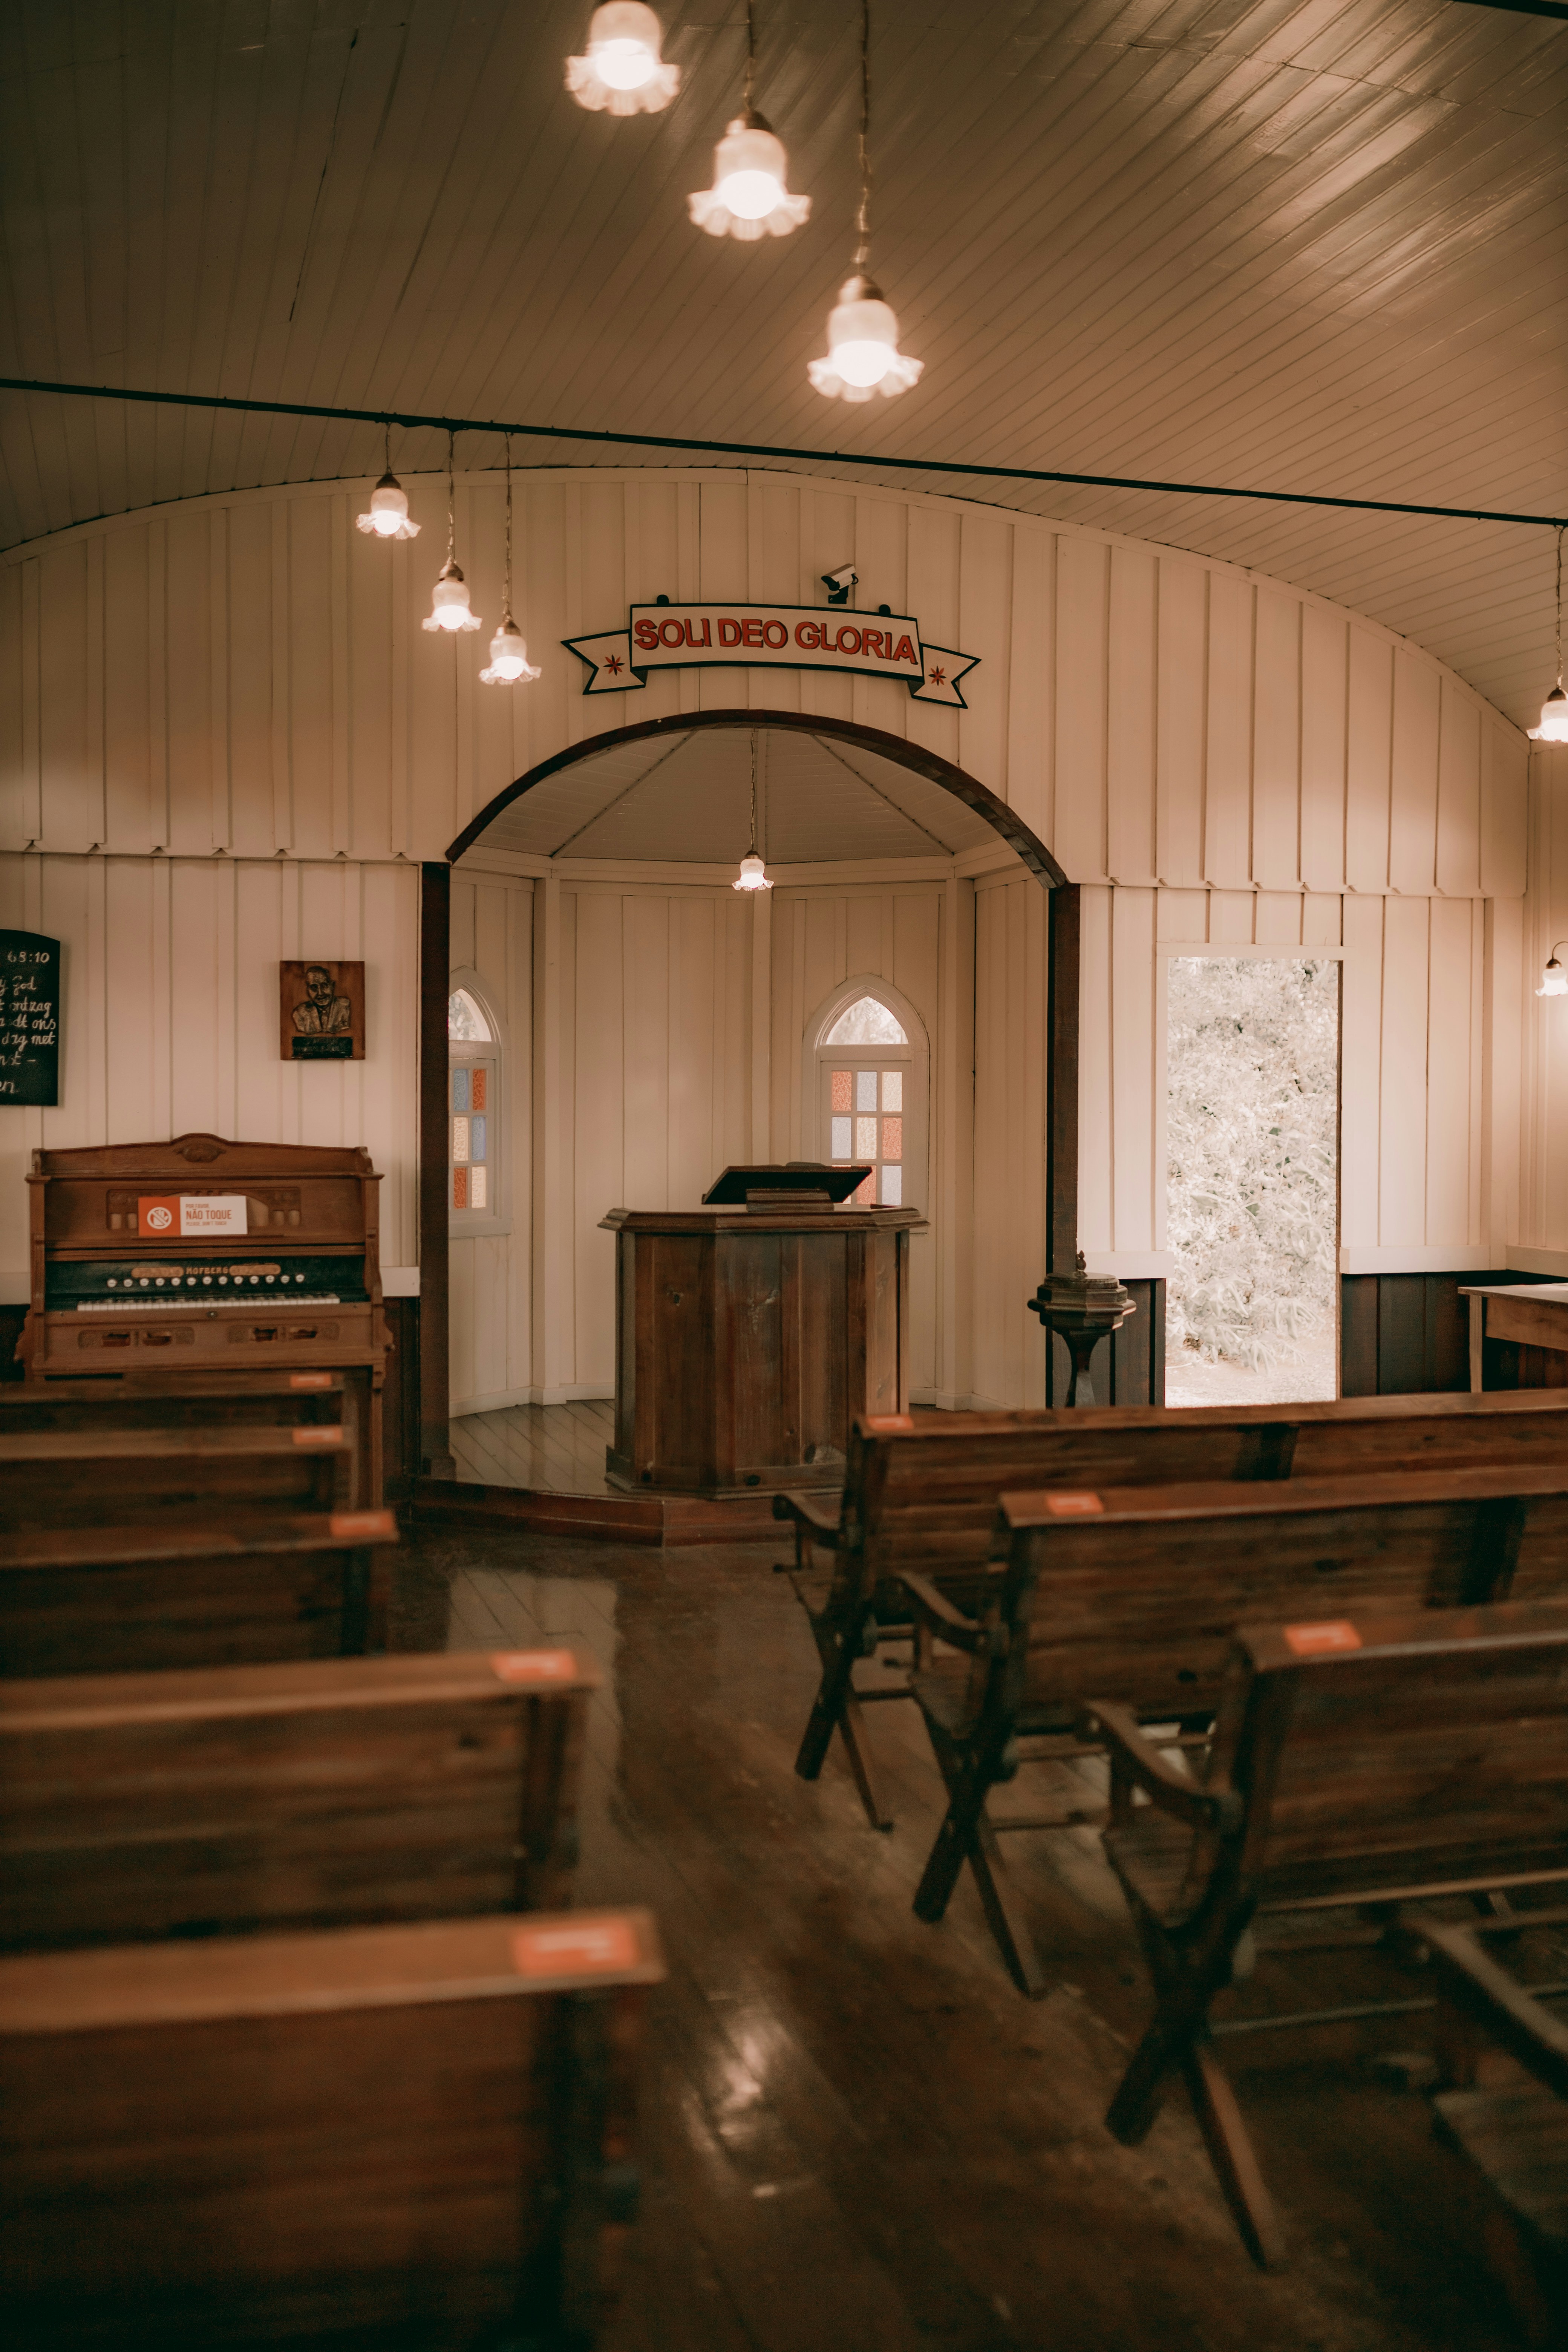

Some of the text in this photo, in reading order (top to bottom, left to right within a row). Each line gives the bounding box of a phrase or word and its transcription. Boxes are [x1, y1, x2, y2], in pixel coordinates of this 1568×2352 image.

[634, 619, 918, 665] SOLI DEO GLORIA
[32, 1018, 56, 1030] ons
[31, 1031, 56, 1045] met
[186, 1209, 232, 1219] NÃO TOQUE
